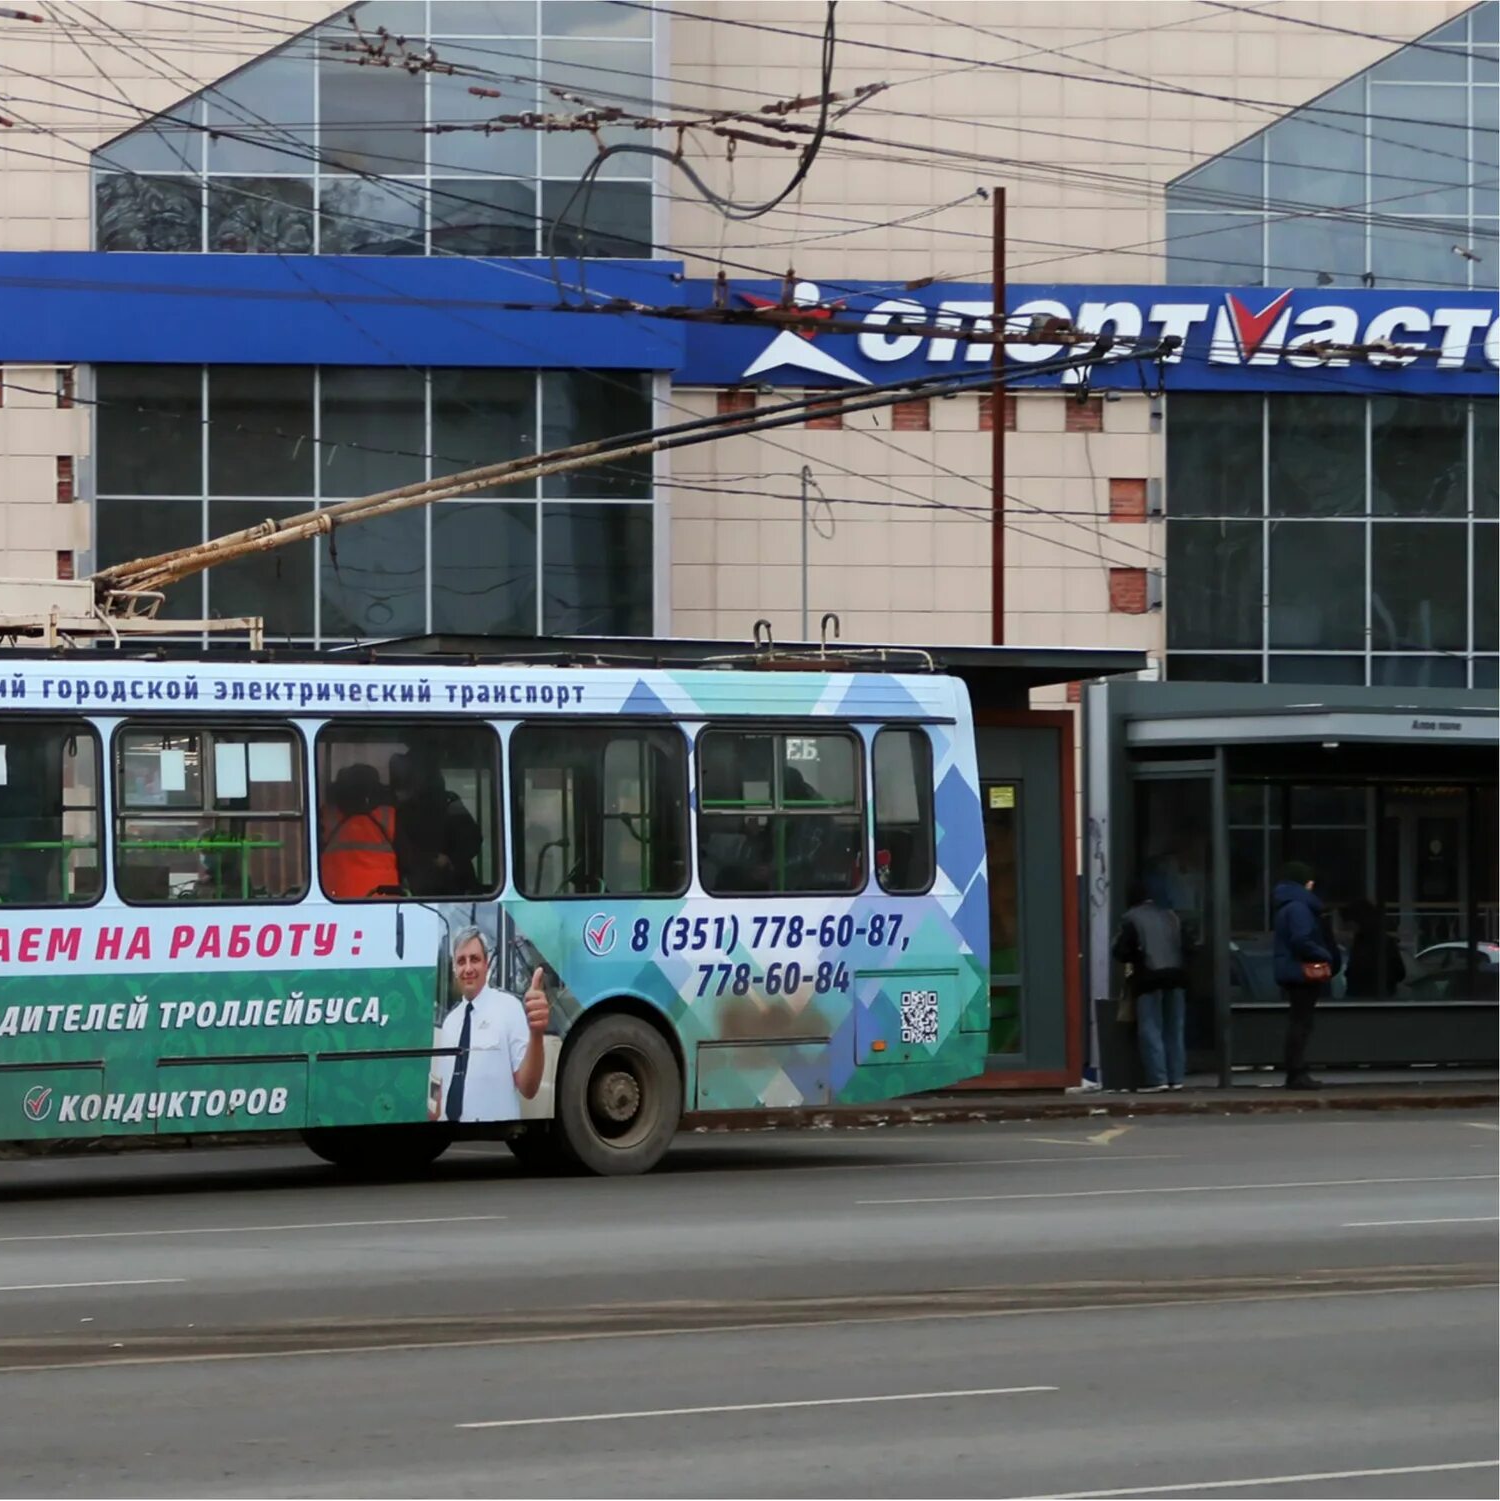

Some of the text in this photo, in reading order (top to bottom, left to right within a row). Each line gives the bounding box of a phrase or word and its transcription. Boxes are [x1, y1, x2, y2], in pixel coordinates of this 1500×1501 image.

[42, 675, 199, 704] городской
[213, 679, 432, 706] электрический
[445, 684, 585, 709] транспорт
[95, 926, 151, 960] НА
[168, 923, 338, 959] РАБОТУ
[630, 914, 910, 957] 8 (351) 778-60-87,
[697, 961, 850, 997] 778-60-84
[158, 991, 390, 1030] ТРОЛЛЕЙБУСА,
[58, 1088, 288, 1125] КОНДУКТОРОВ
